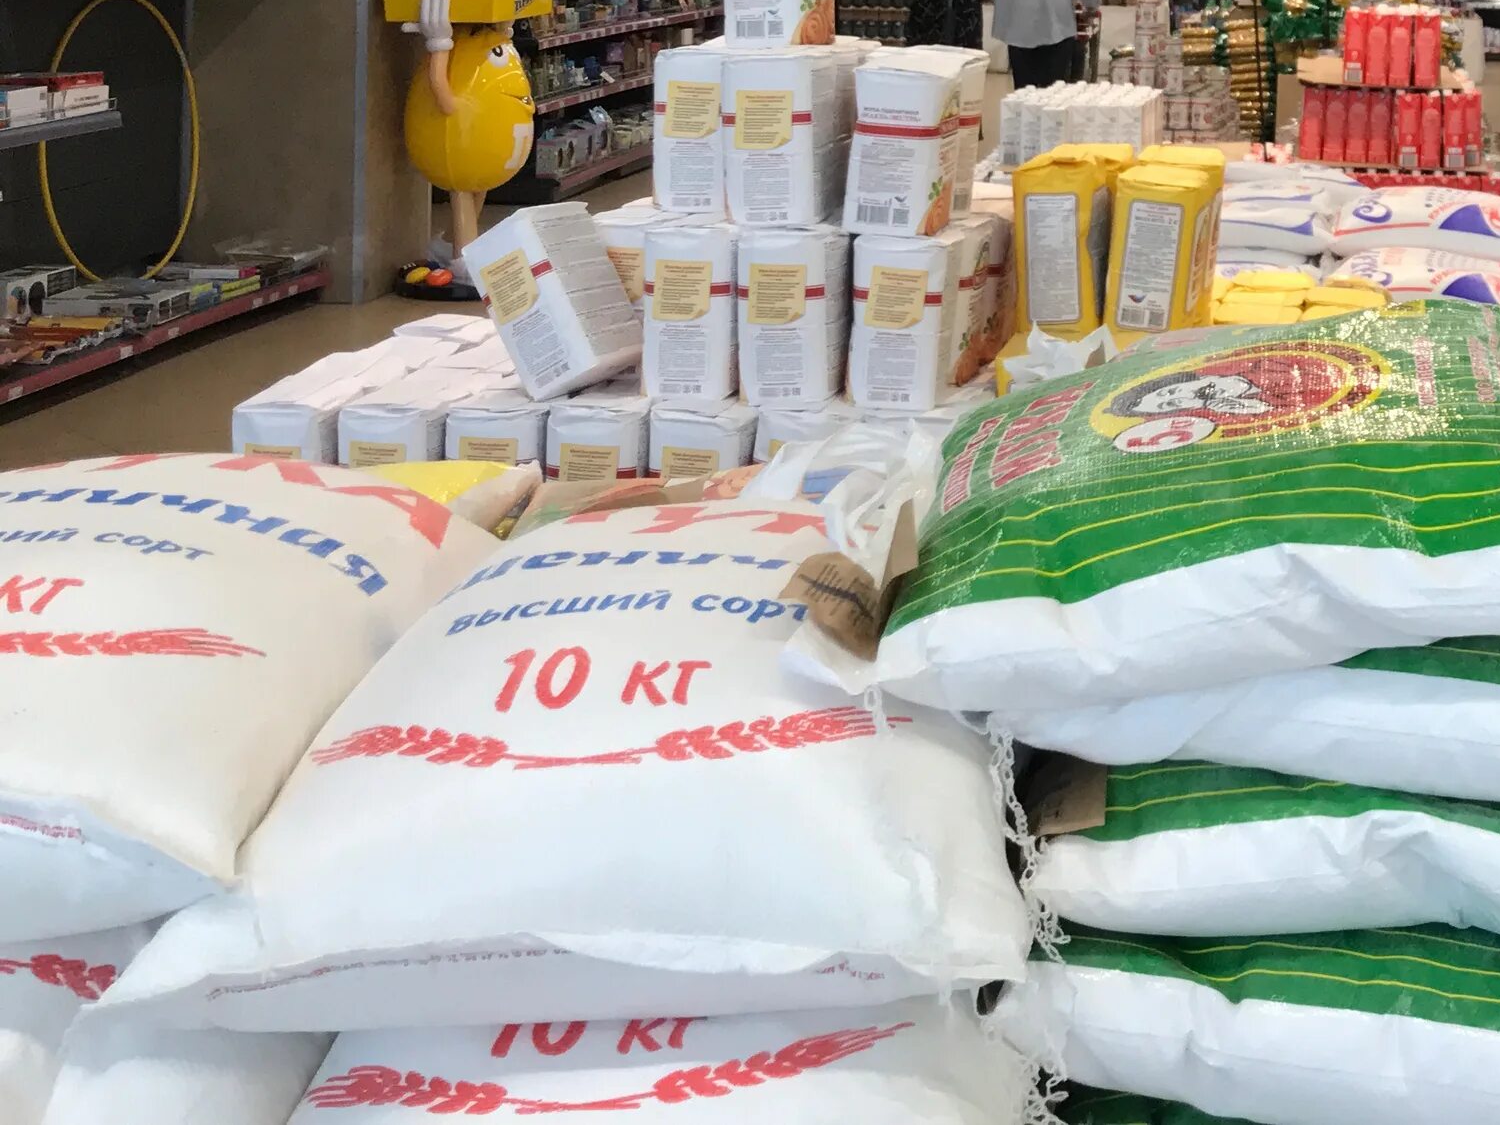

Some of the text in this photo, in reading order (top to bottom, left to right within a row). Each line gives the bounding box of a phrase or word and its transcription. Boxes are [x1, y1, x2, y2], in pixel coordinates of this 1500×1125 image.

[0, 487, 389, 597] ничная
[93, 531, 215, 562] сорт
[444, 589, 672, 637] высший
[494, 645, 712, 713] 10 кг
